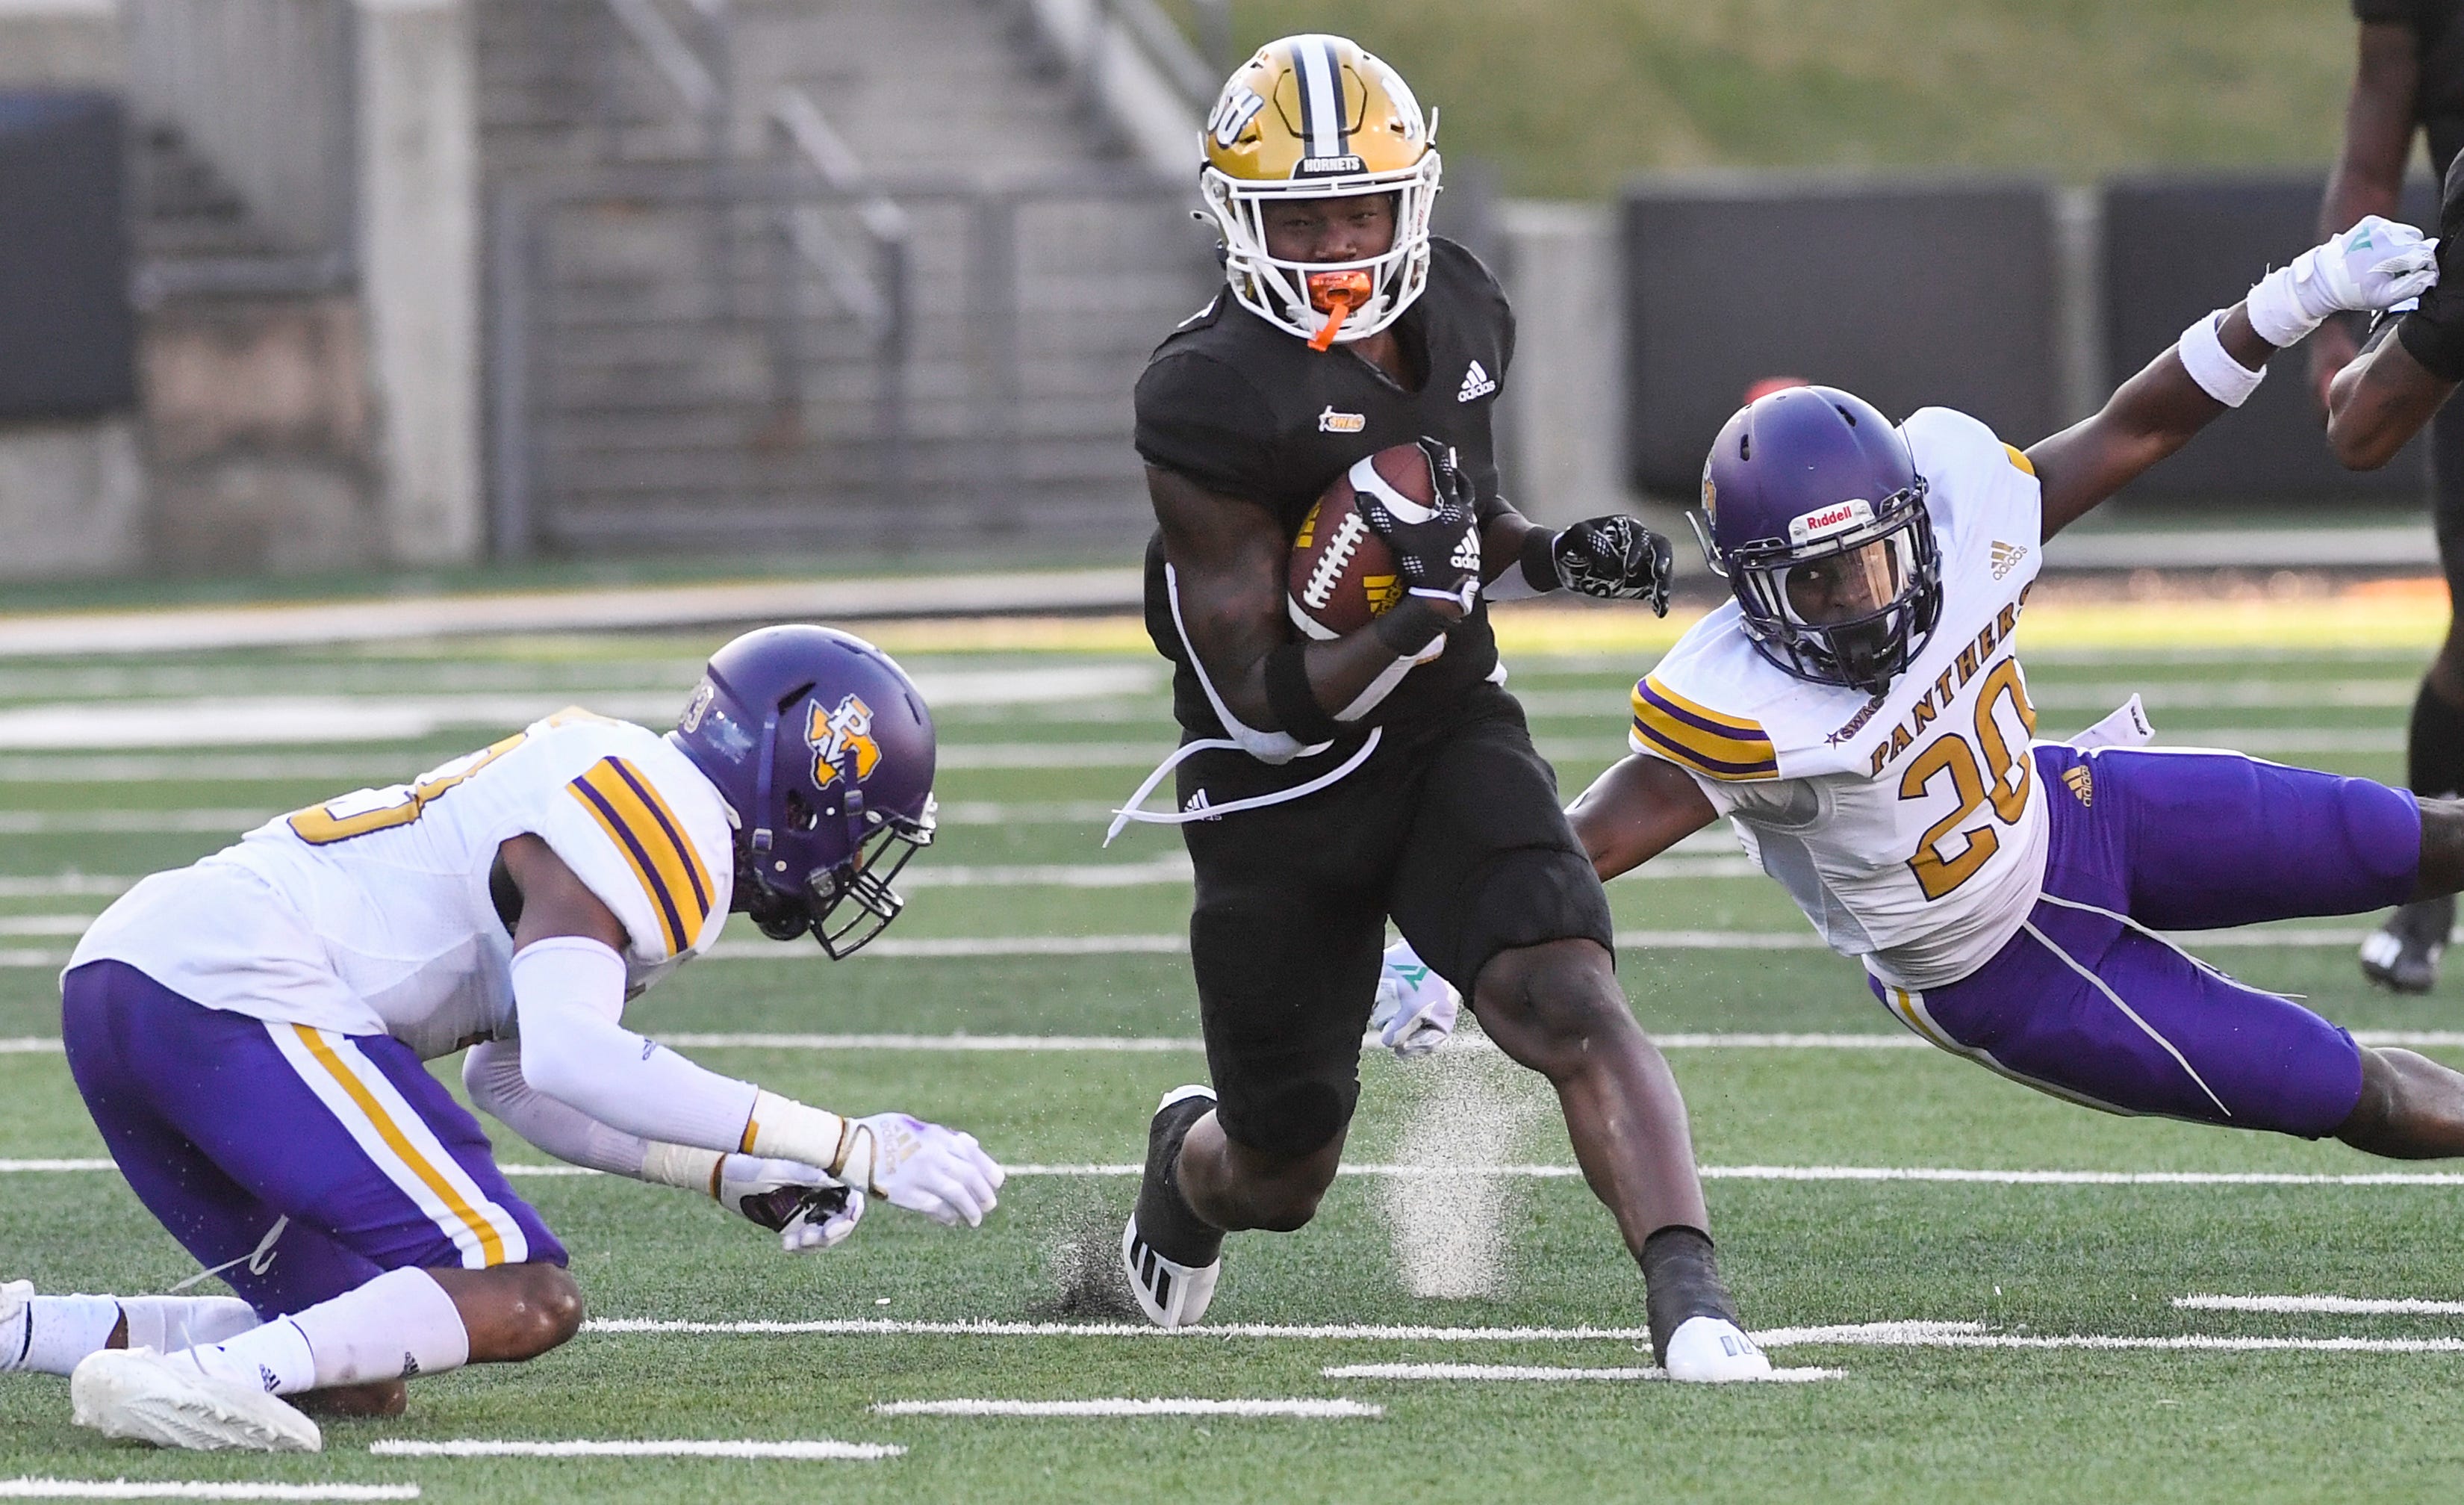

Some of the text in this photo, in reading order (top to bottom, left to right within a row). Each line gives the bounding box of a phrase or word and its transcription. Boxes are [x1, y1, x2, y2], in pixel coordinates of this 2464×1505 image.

[1303, 156, 1360, 173] HORNETS
[1457, 379, 1496, 403] adidas
[1806, 506, 1852, 530] Riddell
[1992, 545, 2028, 580] adidas
[1899, 654, 2037, 902] 20
